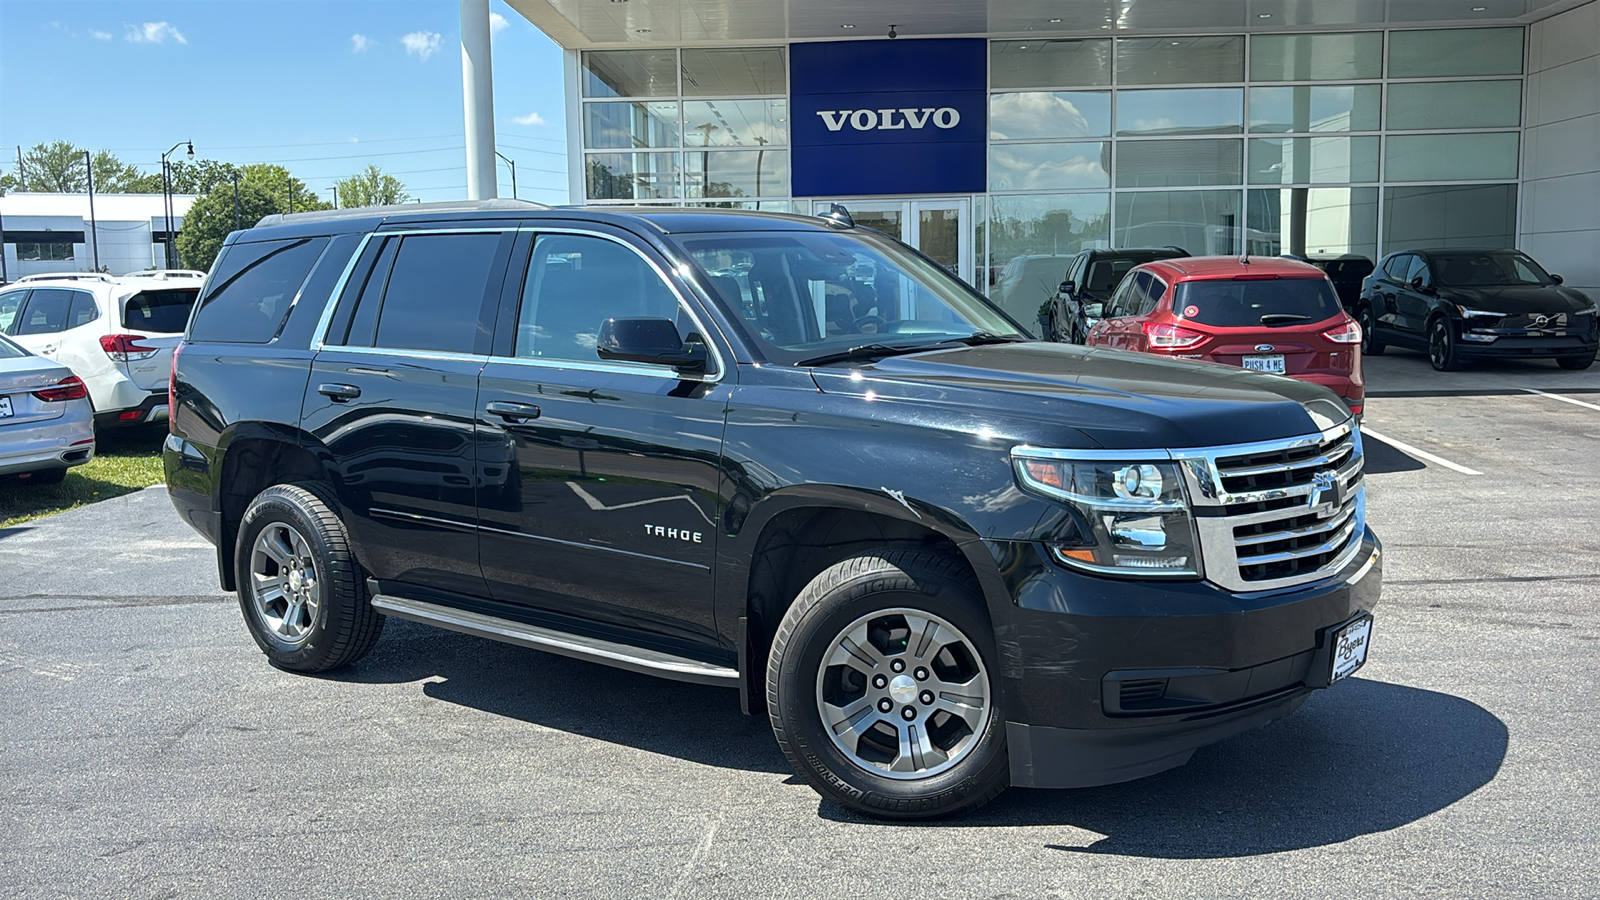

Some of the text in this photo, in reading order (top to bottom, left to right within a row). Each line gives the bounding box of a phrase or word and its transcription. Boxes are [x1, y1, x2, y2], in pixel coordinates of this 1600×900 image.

[816, 107, 961, 132] VOLVO
[1245, 360, 1283, 370] PUSH 4 ME
[644, 524, 702, 543] TAHOE
[850, 578, 938, 599] MICHELIN
[807, 752, 862, 798] DEFENDER
